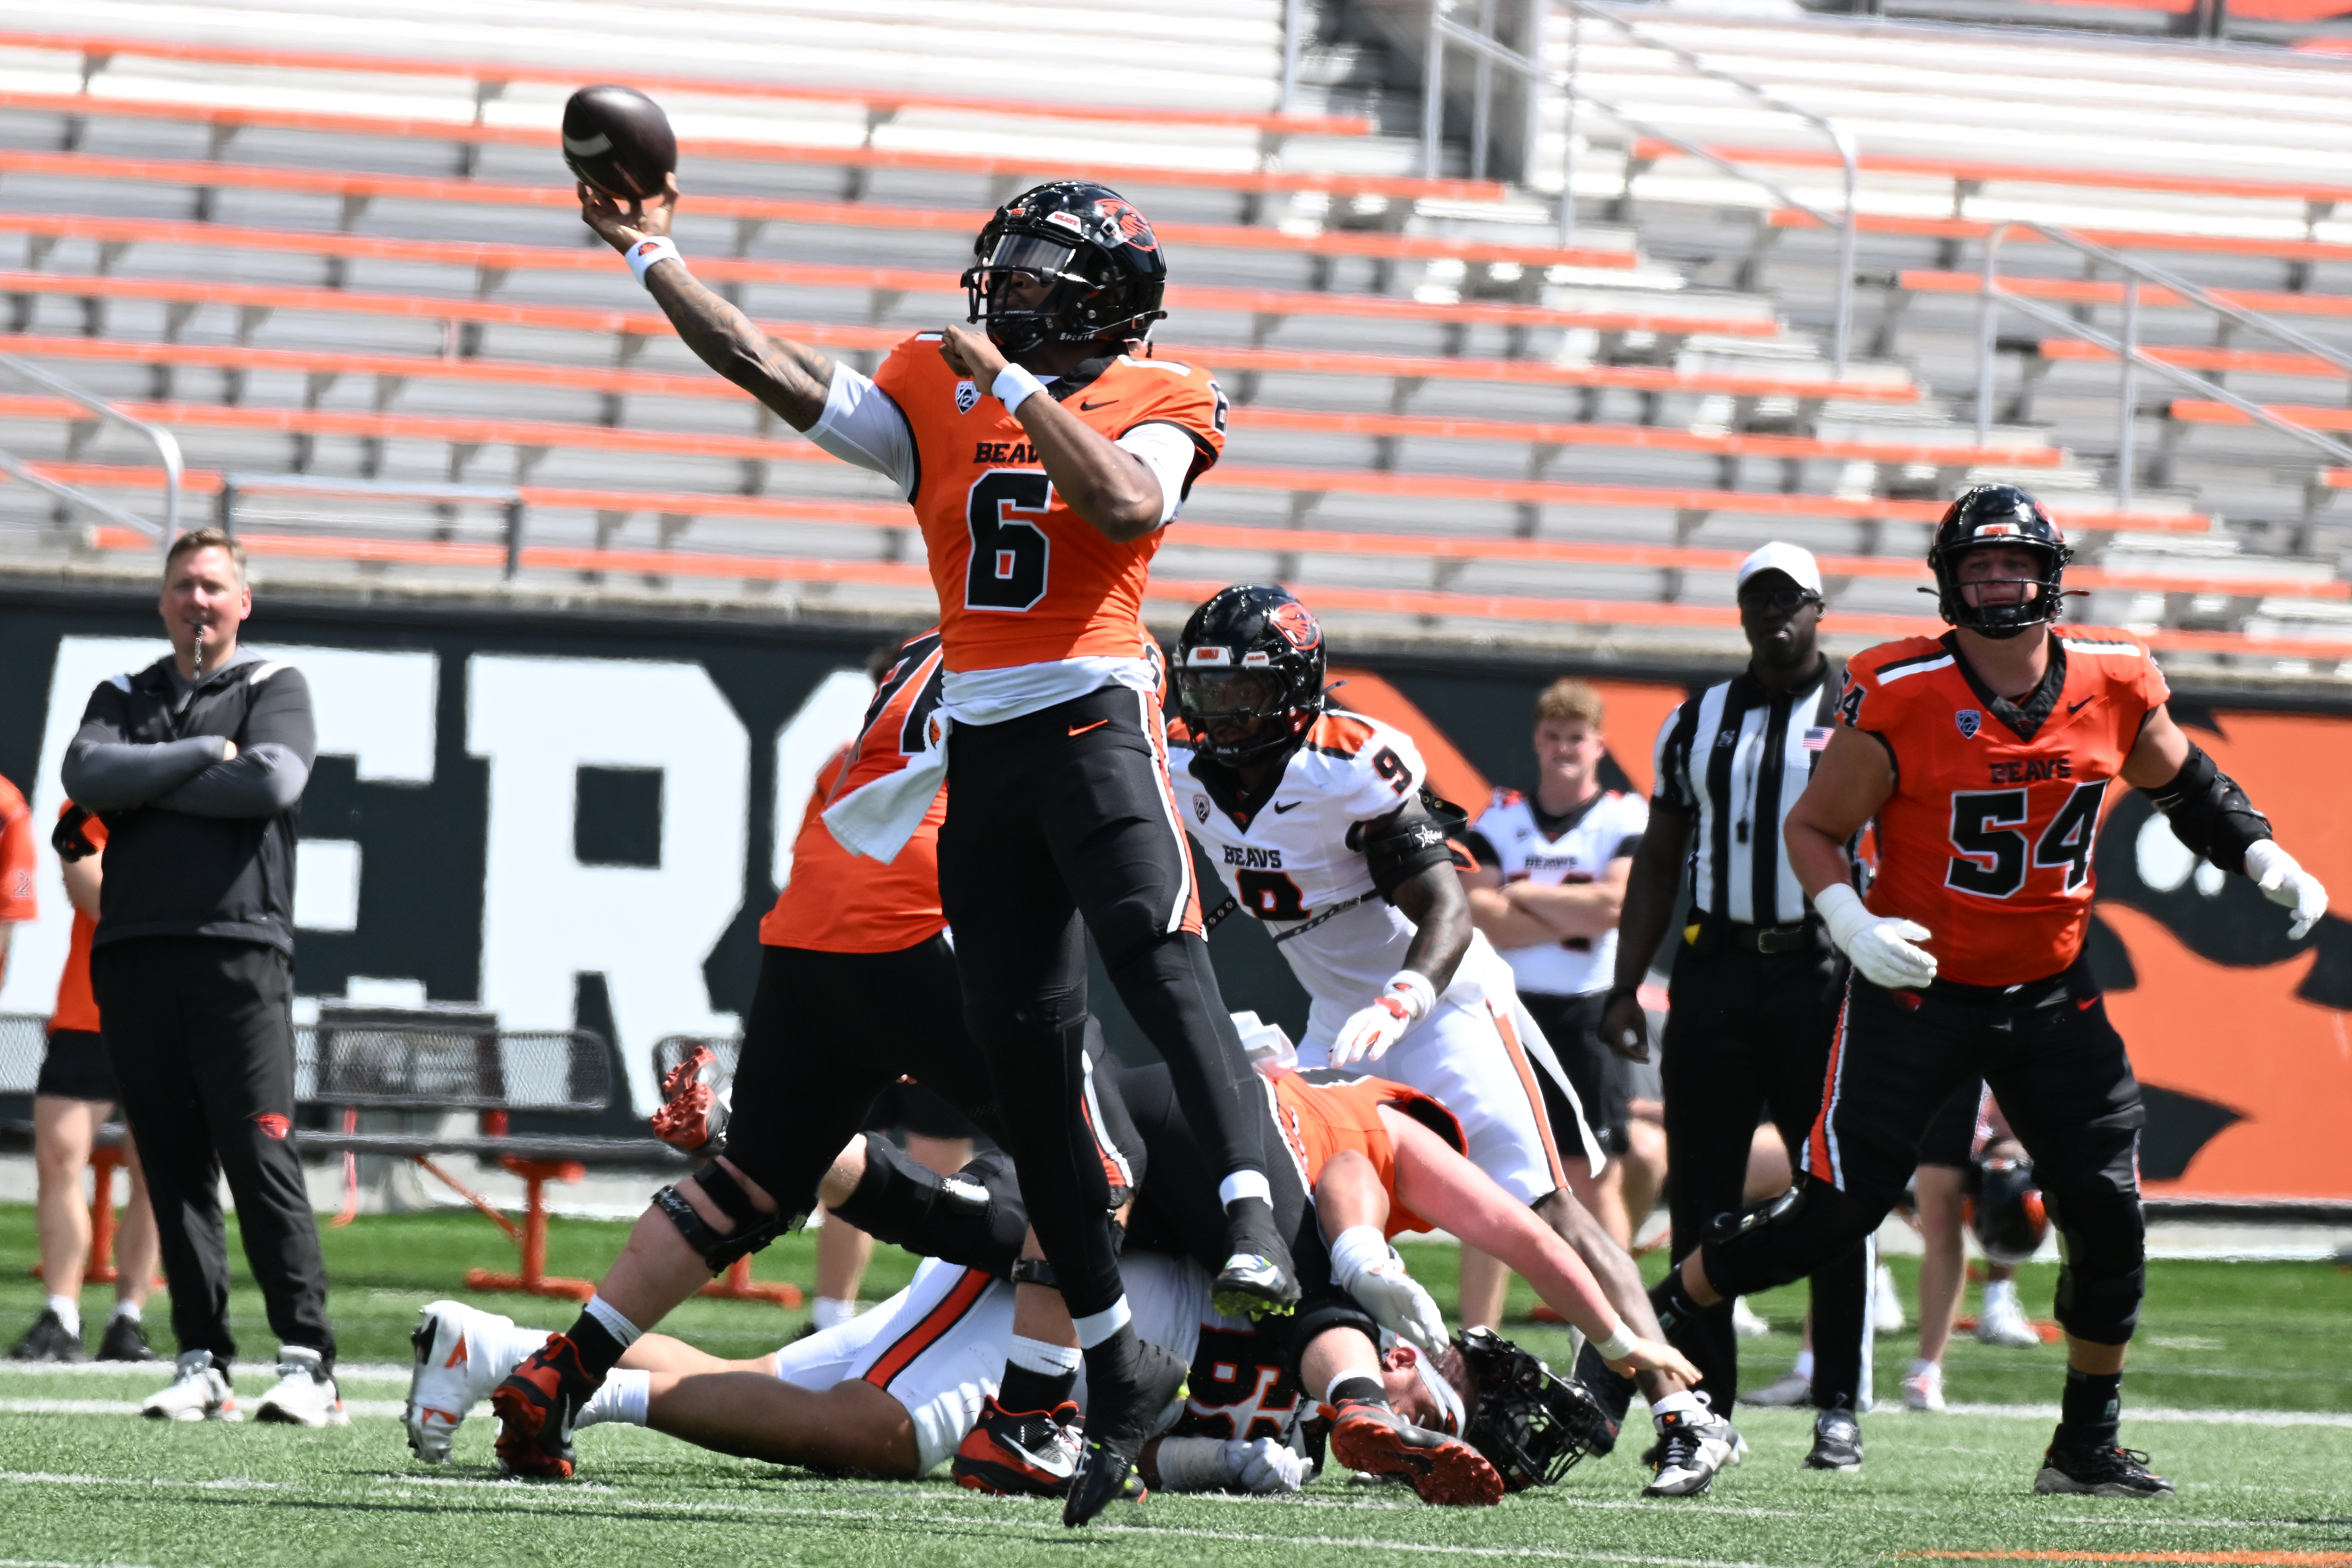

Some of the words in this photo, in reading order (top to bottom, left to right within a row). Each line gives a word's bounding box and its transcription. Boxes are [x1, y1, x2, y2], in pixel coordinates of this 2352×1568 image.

[974, 442, 1039, 464] BEAV
[964, 468, 1054, 613] 6
[1371, 744, 1414, 797] 9
[1990, 759, 2072, 784] BEAVS
[1222, 844, 1282, 868] BEAVS
[1944, 778, 2110, 900] 54
